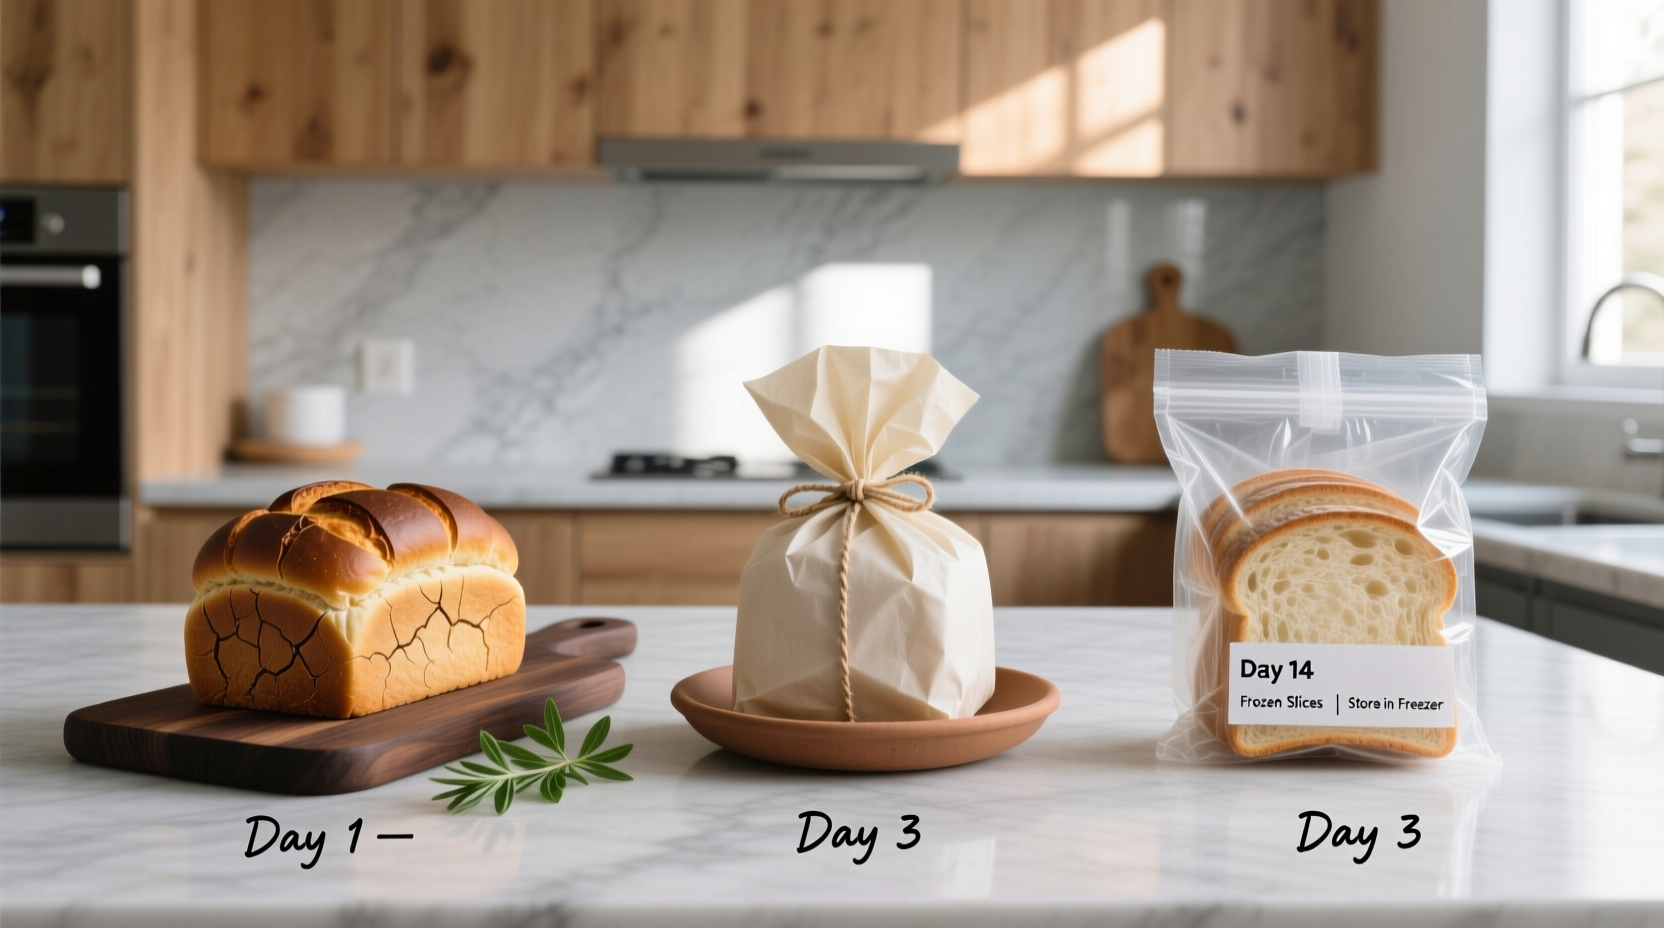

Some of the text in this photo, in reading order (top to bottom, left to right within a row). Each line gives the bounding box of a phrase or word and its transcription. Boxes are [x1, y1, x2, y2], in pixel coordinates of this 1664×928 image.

[1240, 658, 1315, 685] Day 14
[1240, 695, 1324, 709] Frozen Slices
[1348, 696, 1445, 711] Store in Freezer
